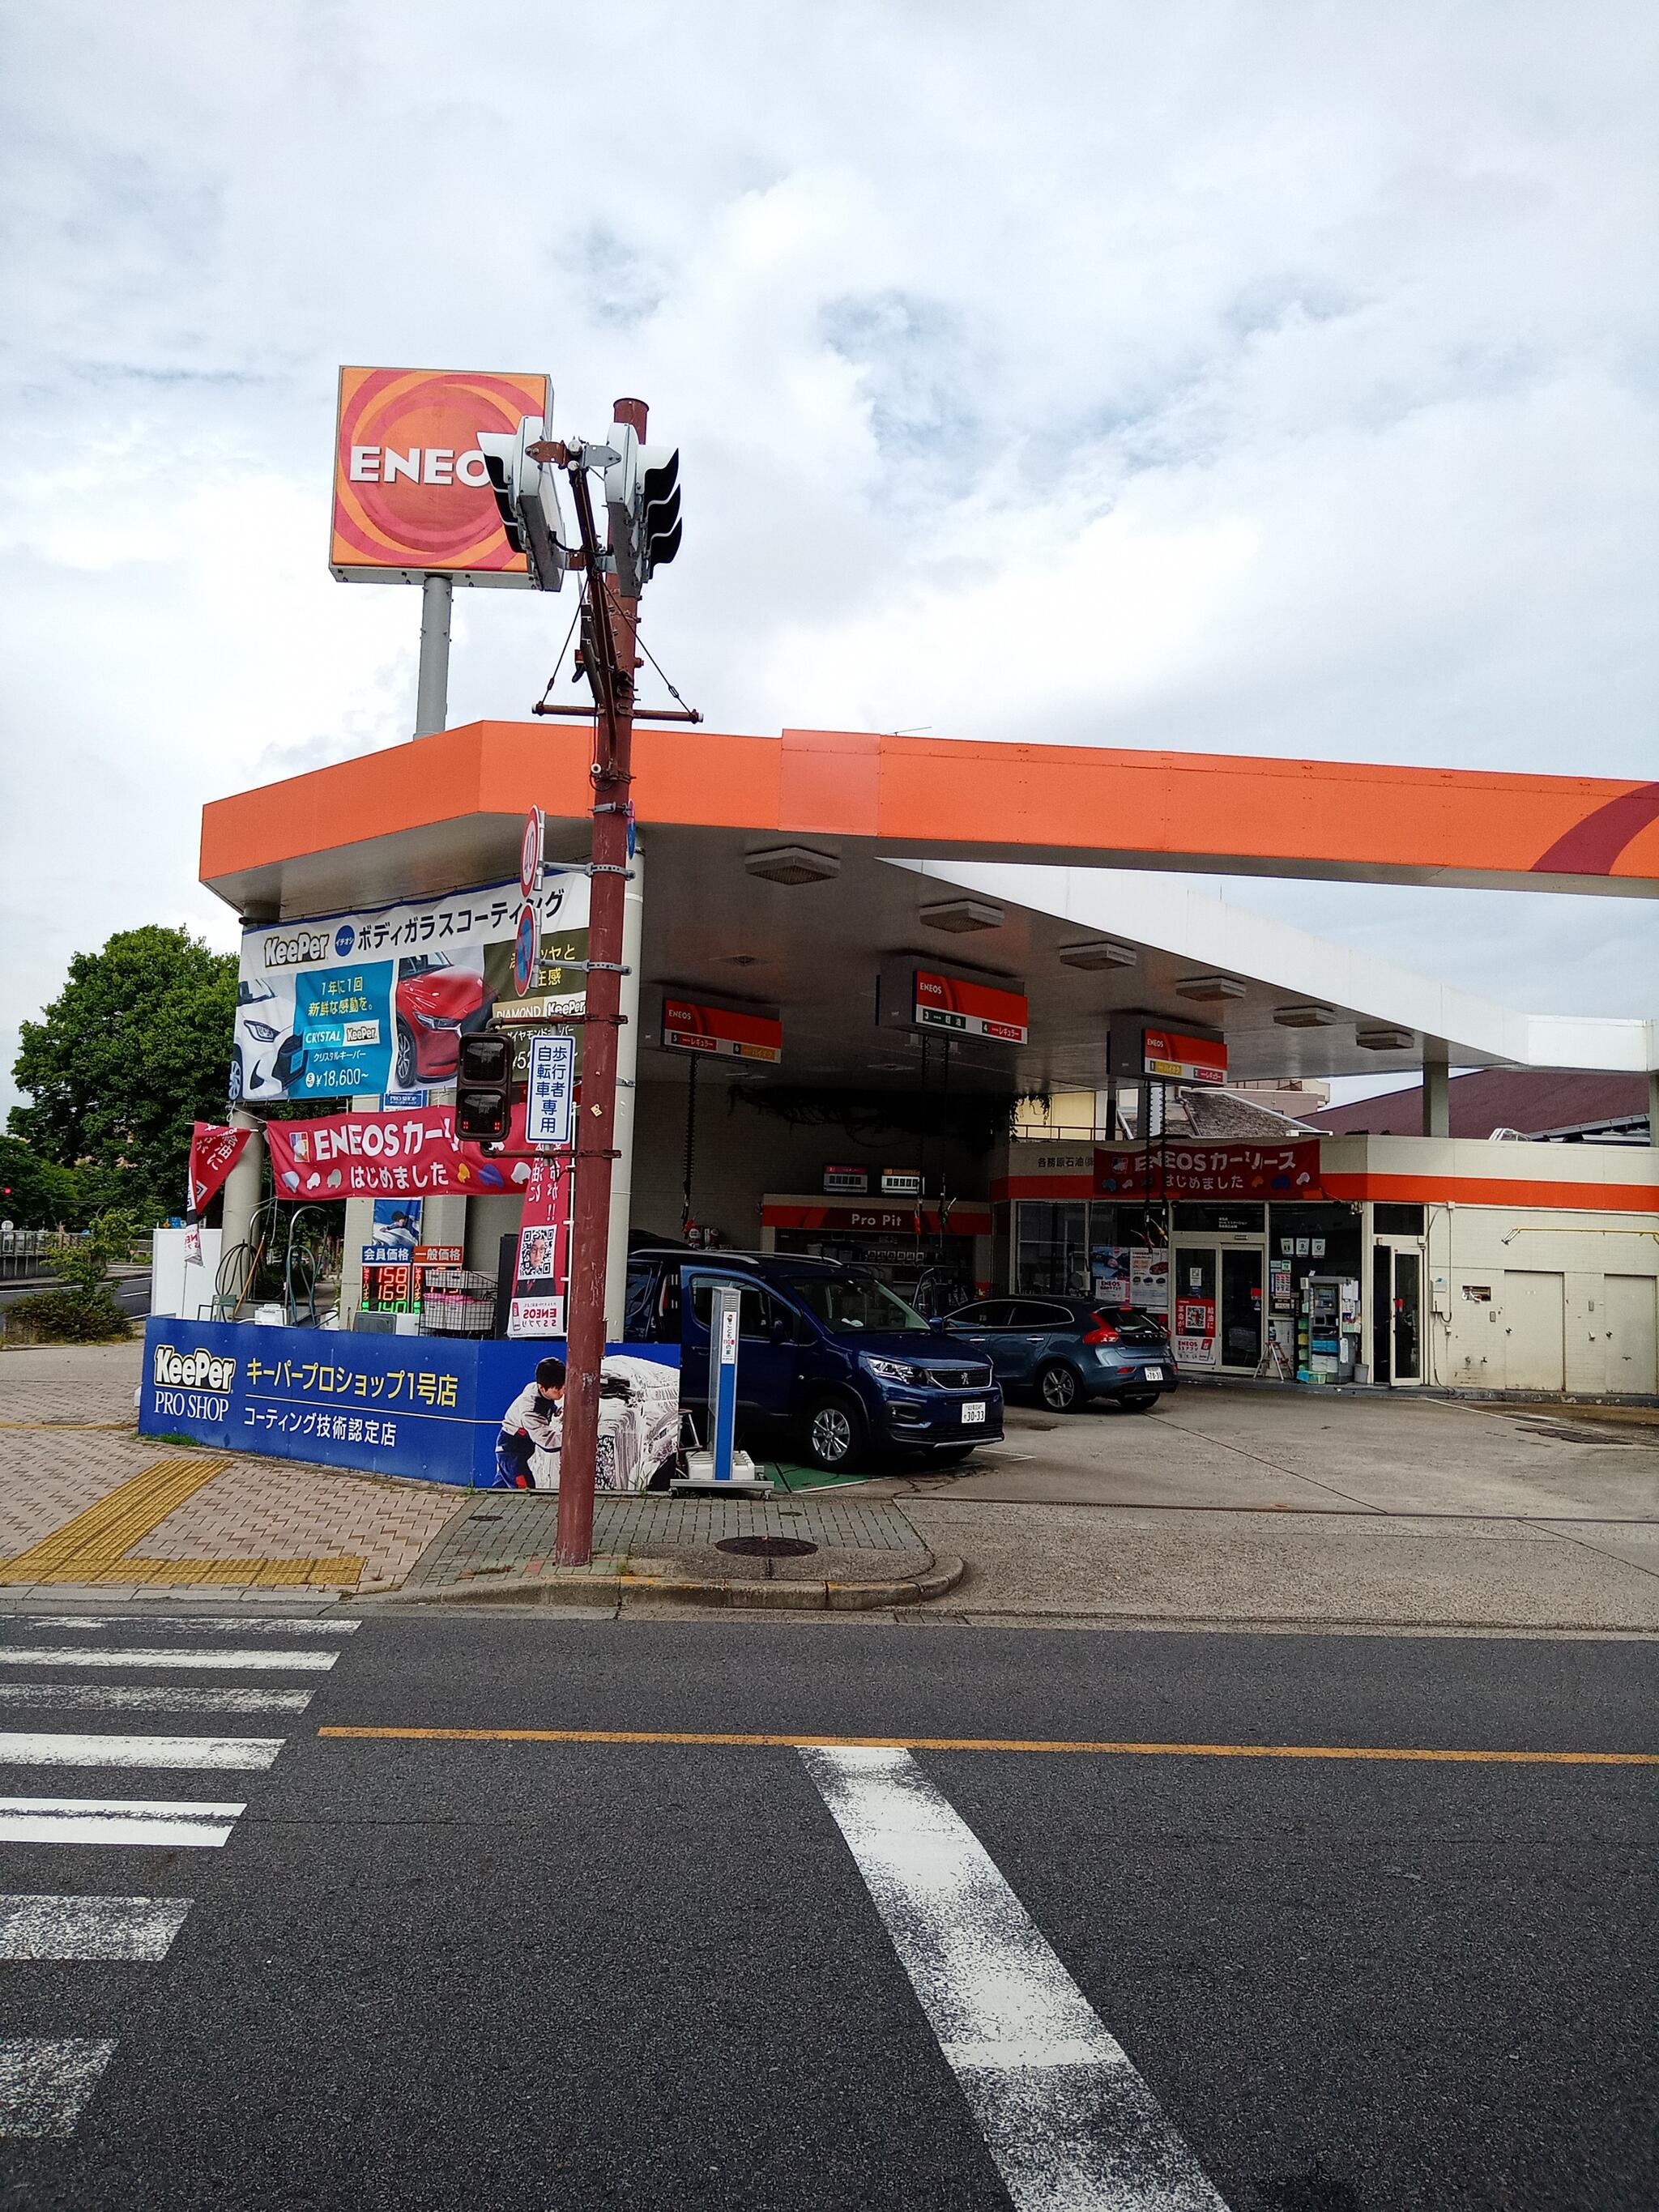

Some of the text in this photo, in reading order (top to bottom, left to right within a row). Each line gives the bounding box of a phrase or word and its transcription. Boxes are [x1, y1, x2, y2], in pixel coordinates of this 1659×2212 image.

[350, 445, 490, 488] ENEO
[264, 932, 330, 968] KeePer
[335, 936, 355, 947] イチオシ
[321, 976, 363, 996] 1年に1回
[919, 982, 942, 995] ENEOS
[308, 997, 373, 1017] 新鮮な感動を。
[547, 999, 586, 1016] KeePer
[668, 1009, 691, 1021] ENEOS
[305, 1026, 377, 1044] CRYSTAL KeePer
[672, 1033, 678, 1042] 5
[1147, 1038, 1164, 1048] ENEOS
[535, 1045, 552, 1097] 自転車
[550, 1046, 567, 1097] 歩行者
[540, 1099, 557, 1134] 専用
[1134, 1150, 1296, 1172] ENEOSカーリース
[350, 1161, 450, 1189] はじめました
[1166, 1174, 1244, 1190] はじめました
[851, 1213, 902, 1227] Pro Pit
[364, 1247, 409, 1261] 会員価格
[415, 1248, 461, 1261] 一般価格
[377, 1267, 407, 1284] 158
[377, 1284, 407, 1301] 169
[154, 1345, 236, 1393] KeePer
[245, 1357, 458, 1408] キーパープロショップ1号店
[154, 1391, 229, 1422] PRO SHOP
[244, 1406, 397, 1447] コーティング技術認定店
